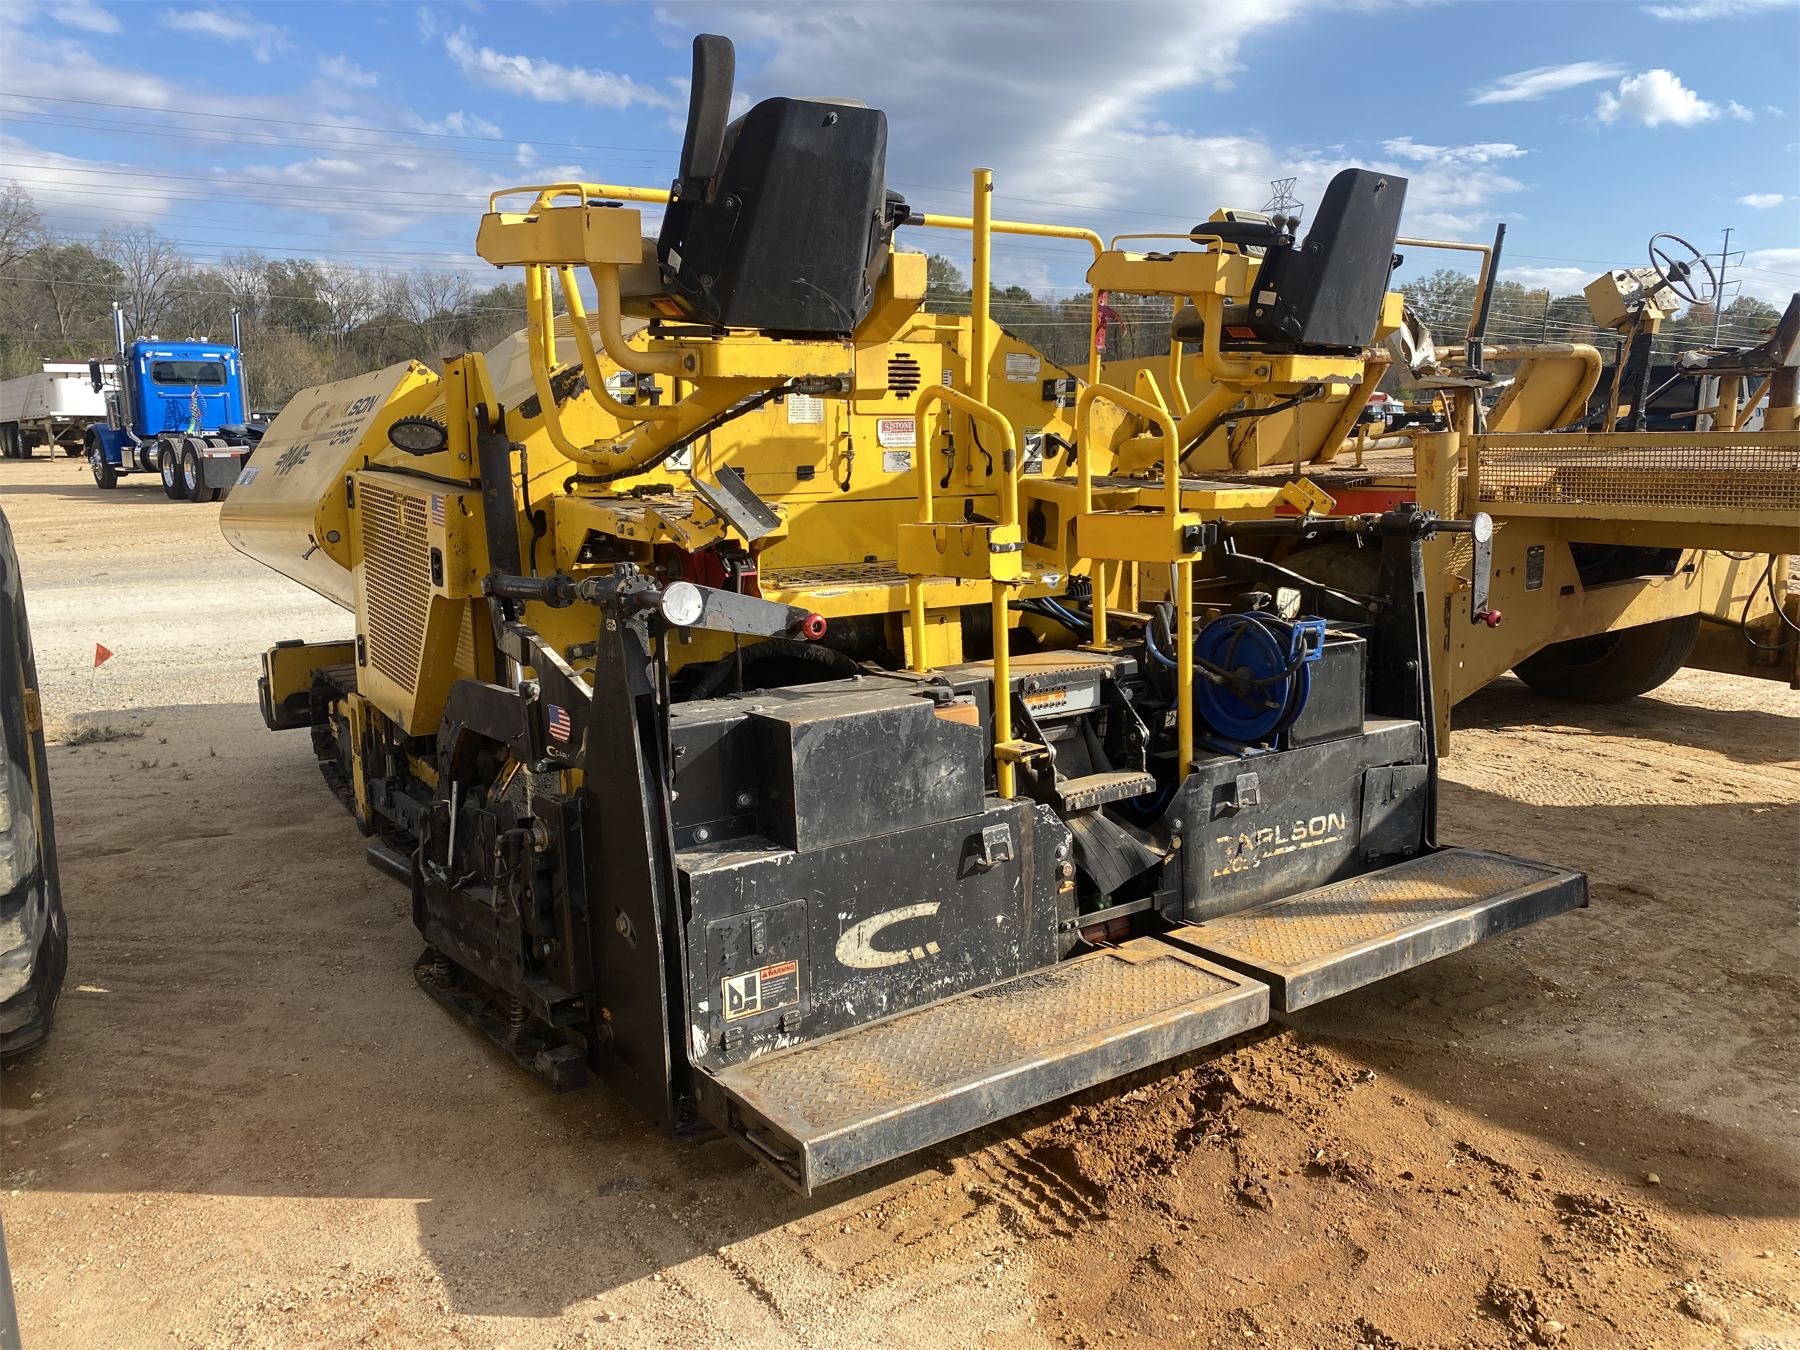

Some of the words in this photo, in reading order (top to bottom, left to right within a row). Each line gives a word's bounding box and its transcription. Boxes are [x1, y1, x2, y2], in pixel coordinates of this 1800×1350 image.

[892, 421, 913, 429] STONE
[1216, 811, 1346, 856] ARLSON
[768, 964, 795, 977] WARNING
